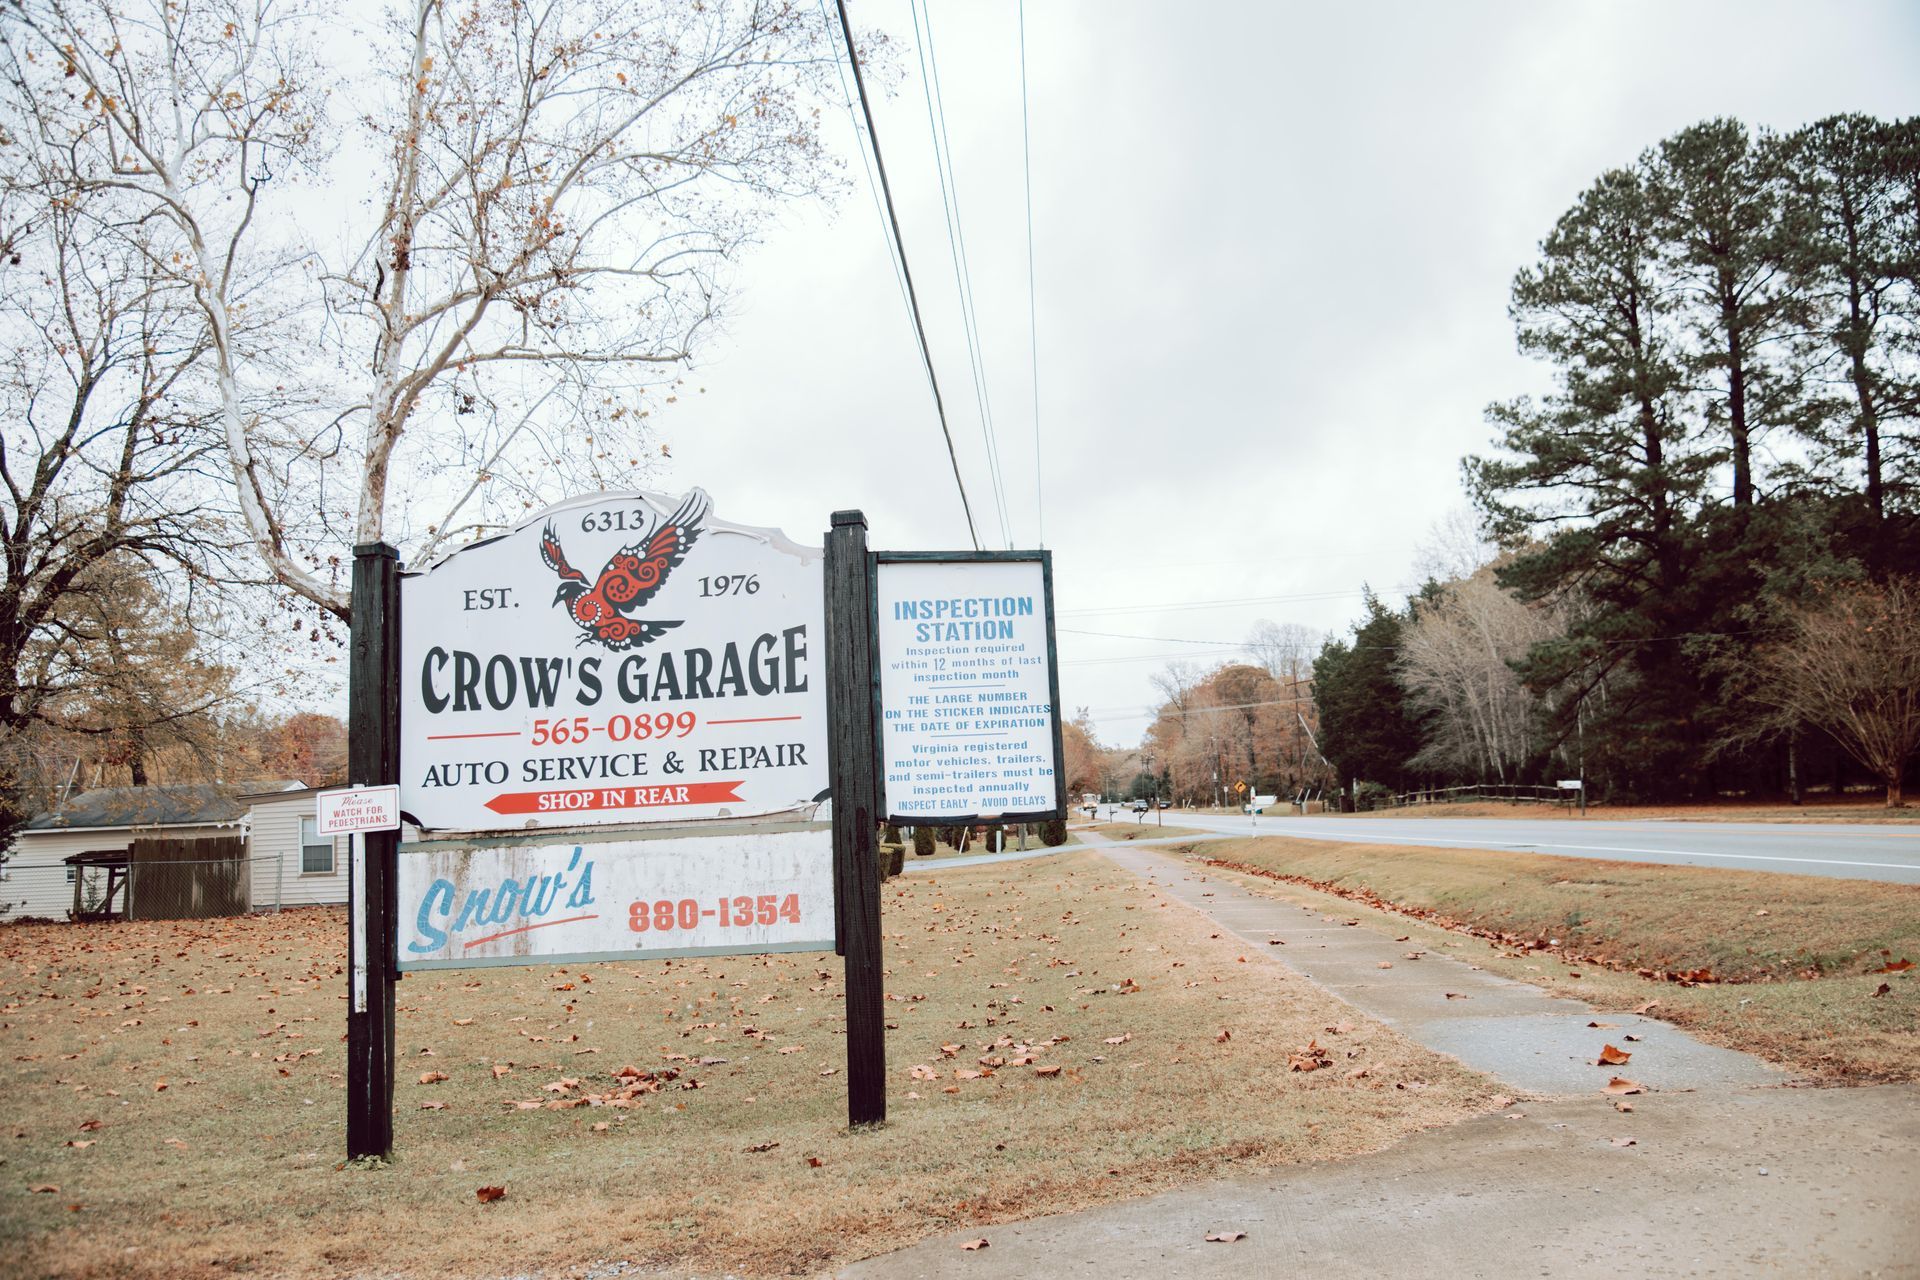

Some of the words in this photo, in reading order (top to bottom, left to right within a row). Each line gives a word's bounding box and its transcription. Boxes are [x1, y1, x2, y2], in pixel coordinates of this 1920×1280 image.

[580, 509, 645, 533] 6313
[698, 573, 760, 598] 1976
[463, 588, 520, 611] EST.
[894, 596, 1033, 620] INSPECTION
[916, 620, 1014, 642] STATION
[906, 645, 969, 656] Inspection
[975, 643, 1025, 654] required
[421, 646, 602, 714] CROW'S
[617, 624, 808, 704] GARAGE
[892, 660, 928, 670] within
[934, 658, 946, 671] 12
[952, 658, 995, 668] months
[1001, 656, 1013, 666] of
[1019, 655, 1042, 665] last
[914, 671, 977, 683] inspection
[982, 669, 1019, 680] month
[908, 695, 930, 705] THE
[935, 693, 973, 704] LARGE
[978, 691, 1027, 702] NUMBER
[885, 710, 901, 719] ON
[906, 709, 929, 718] THE
[934, 706, 984, 717] STICKER
[989, 704, 1051, 715] INDICATES
[531, 711, 697, 746] 565-0899
[893, 723, 915, 732] THE
[921, 721, 950, 731] DATE
[956, 721, 970, 730] OF
[975, 718, 1045, 729] EXPIRATION
[912, 743, 959, 754] Virginia
[964, 741, 1028, 753] registered
[422, 760, 510, 788] AUTO
[522, 753, 648, 782] SERVICE
[661, 751, 685, 775] &
[699, 743, 808, 772] REPAIR
[895, 758, 931, 768] motor
[889, 772, 910, 782] and
[916, 769, 997, 781] semi-trailers
[1003, 767, 1033, 777] must
[1039, 767, 1053, 776] be
[913, 784, 973, 795] inspected
[979, 781, 1030, 793] annually
[341, 796, 373, 807] Please
[538, 791, 595, 811] SHOP
[601, 790, 626, 806] IN
[634, 786, 690, 805] REAR
[898, 800, 936, 811] INSPECT
[940, 799, 969, 809] EARLY
[981, 797, 1008, 808] AVOID
[1012, 795, 1046, 807] DELAYS
[333, 807, 362, 818] WATCH
[366, 806, 383, 815] FOR
[329, 815, 388, 827] PEDESTRIANS
[407, 846, 596, 954] Snow's
[629, 893, 801, 933] 880-1354
